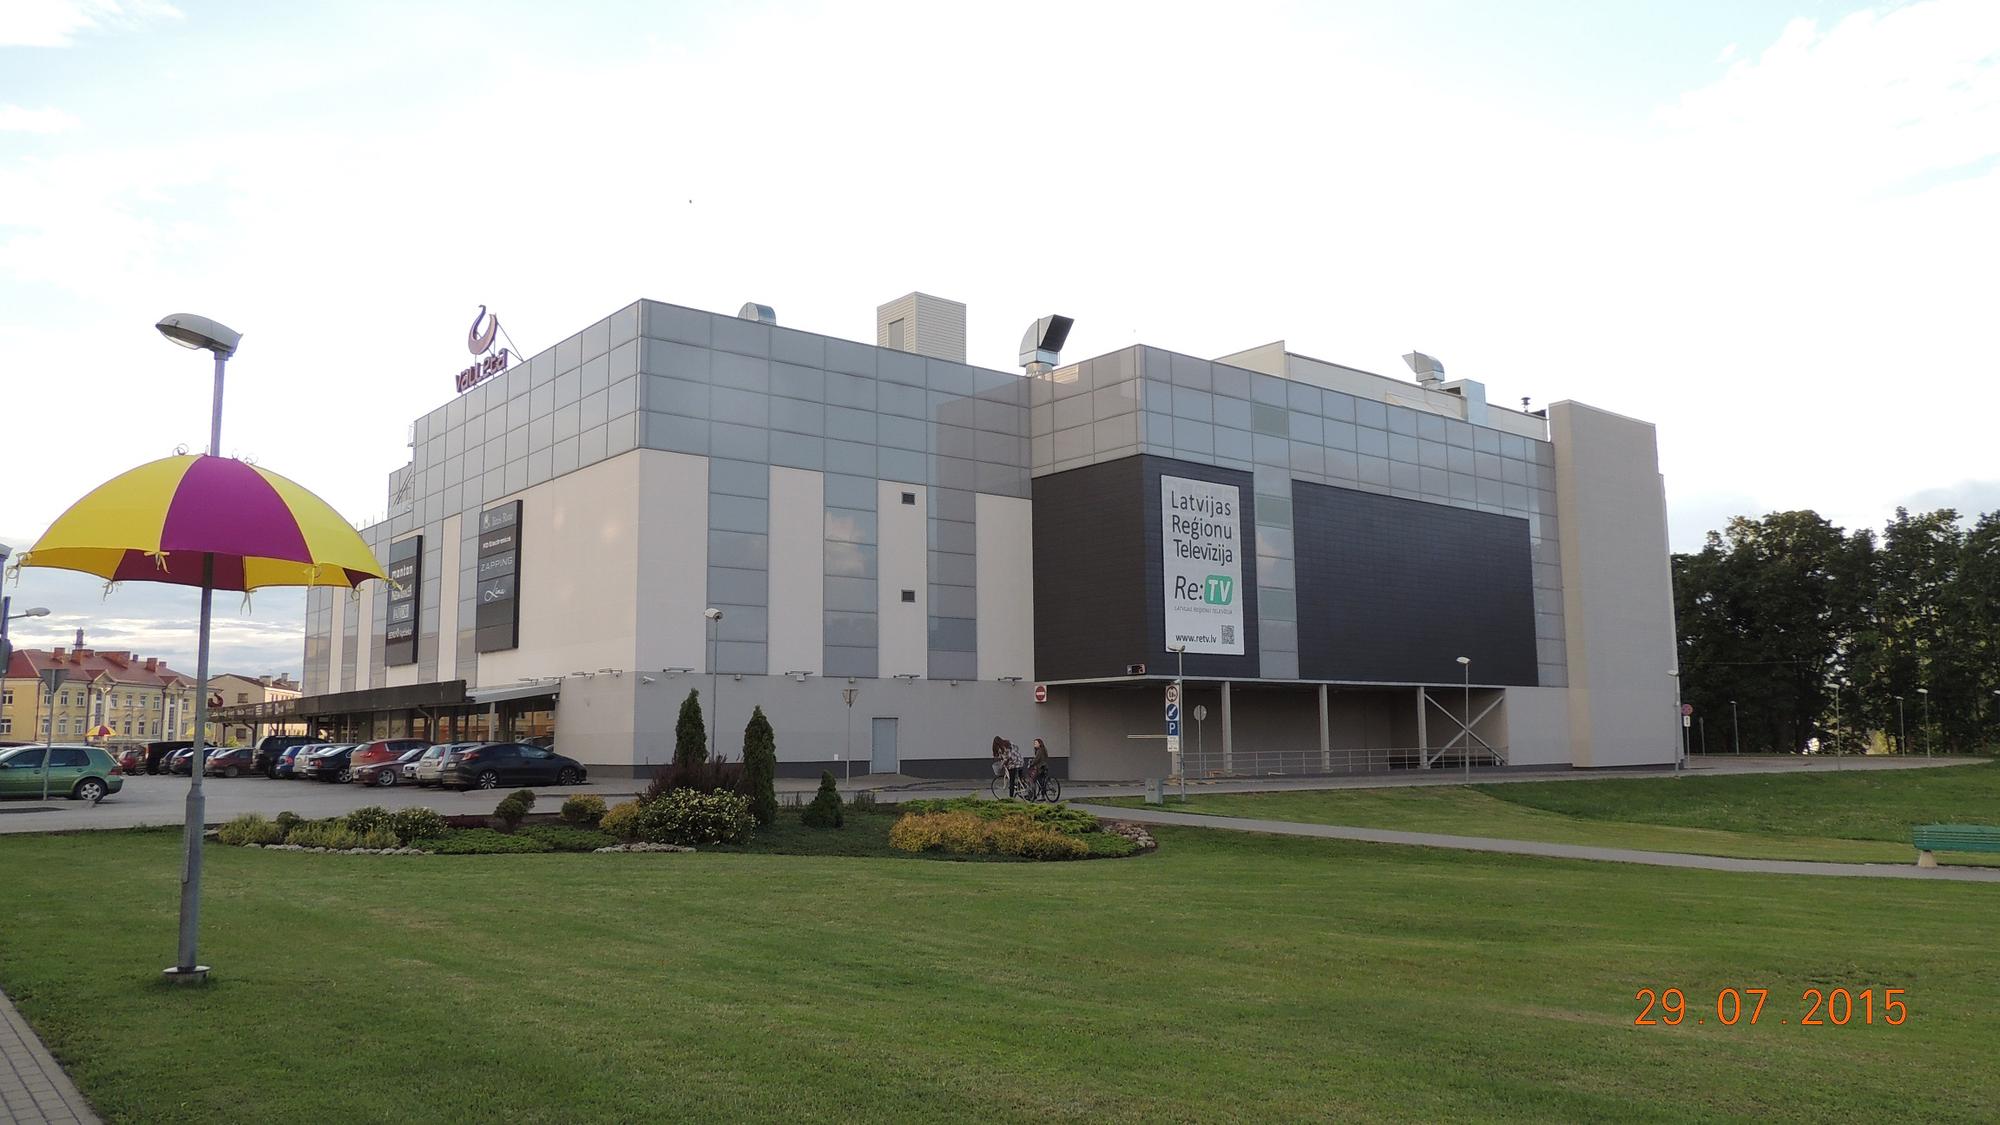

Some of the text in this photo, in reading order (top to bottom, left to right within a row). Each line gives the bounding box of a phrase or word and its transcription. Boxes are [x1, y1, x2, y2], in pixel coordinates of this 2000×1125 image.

[1171, 490, 1231, 518] Latvijas
[1172, 514, 1232, 541] Reģionu
[1173, 538, 1233, 567] Televīzija
[480, 556, 513, 572] ZAPPING
[1175, 634, 1217, 643] www.retv.lv
[1169, 722, 1176, 735] P
